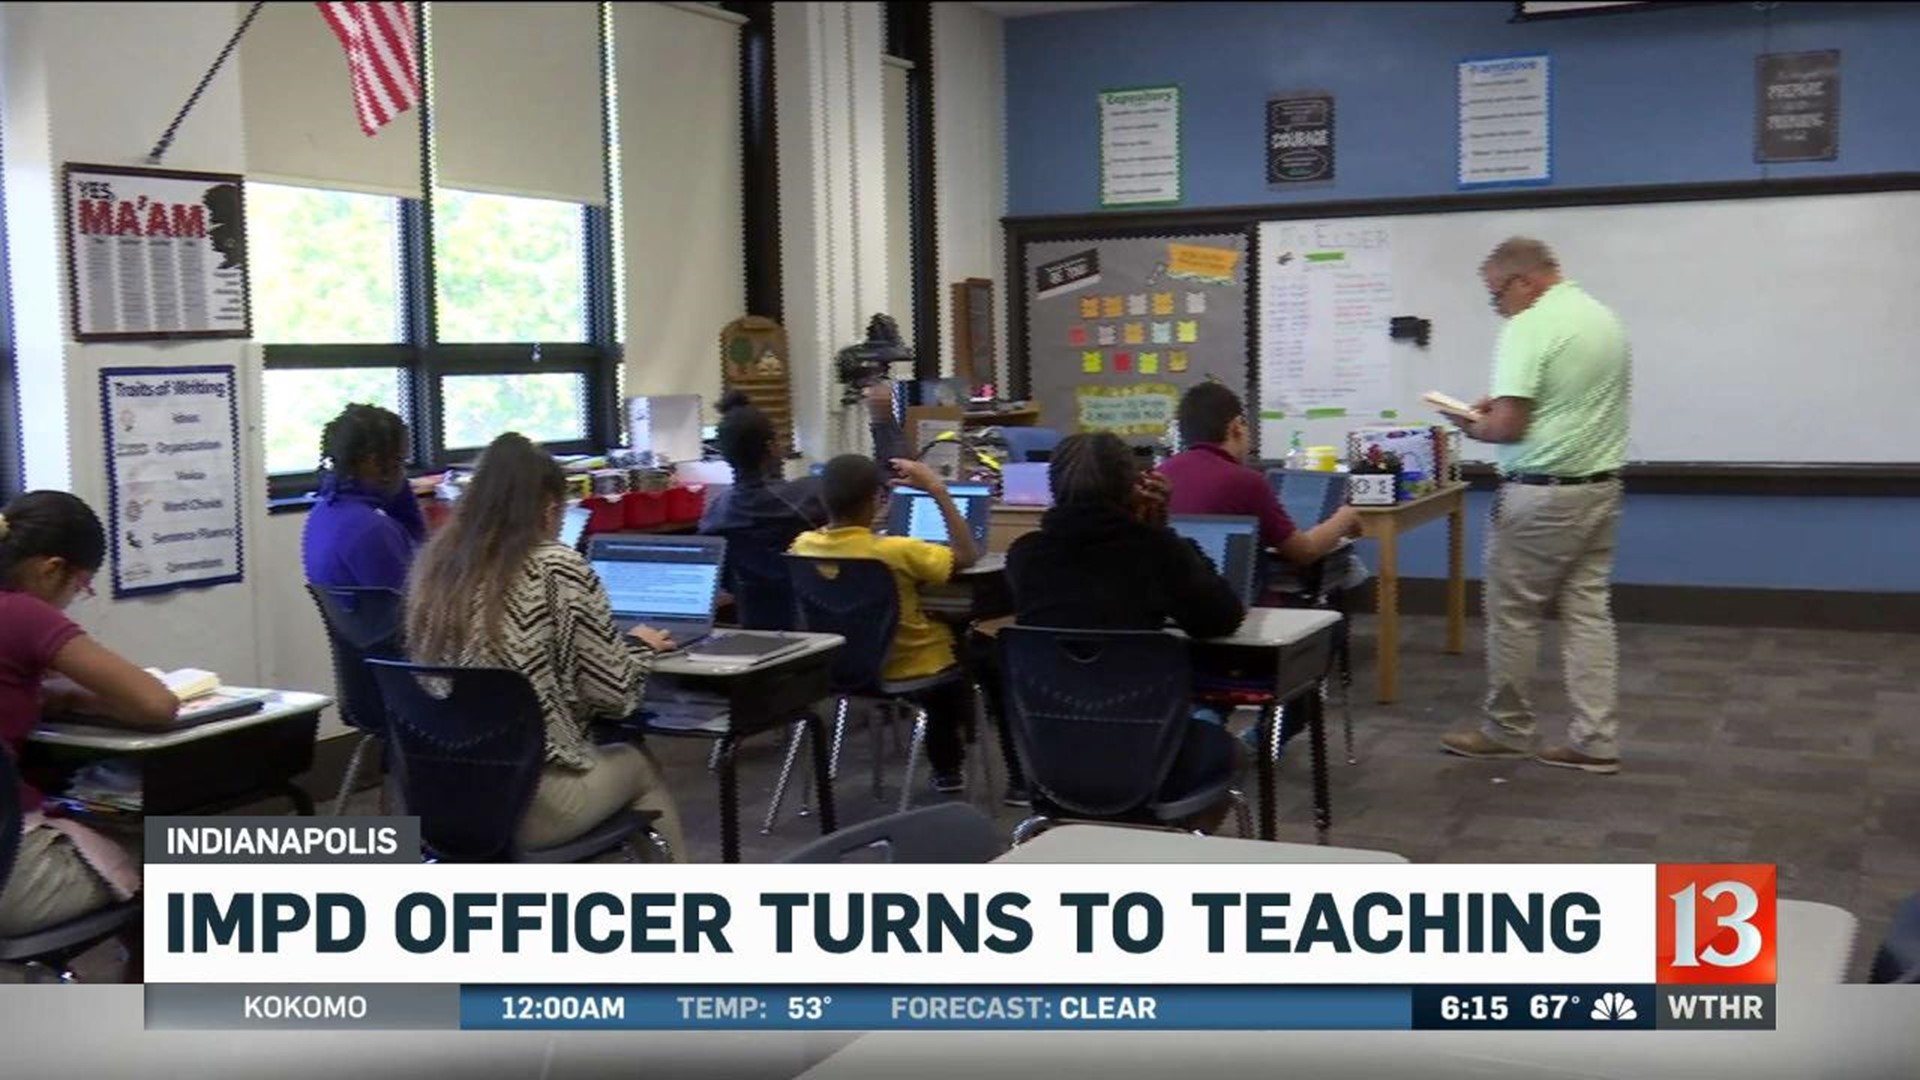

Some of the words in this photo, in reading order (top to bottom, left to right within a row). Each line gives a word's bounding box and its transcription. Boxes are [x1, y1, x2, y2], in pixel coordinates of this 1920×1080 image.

[115, 382, 153, 397] Traits
[154, 380, 170, 396] of
[173, 379, 225, 398] Writing
